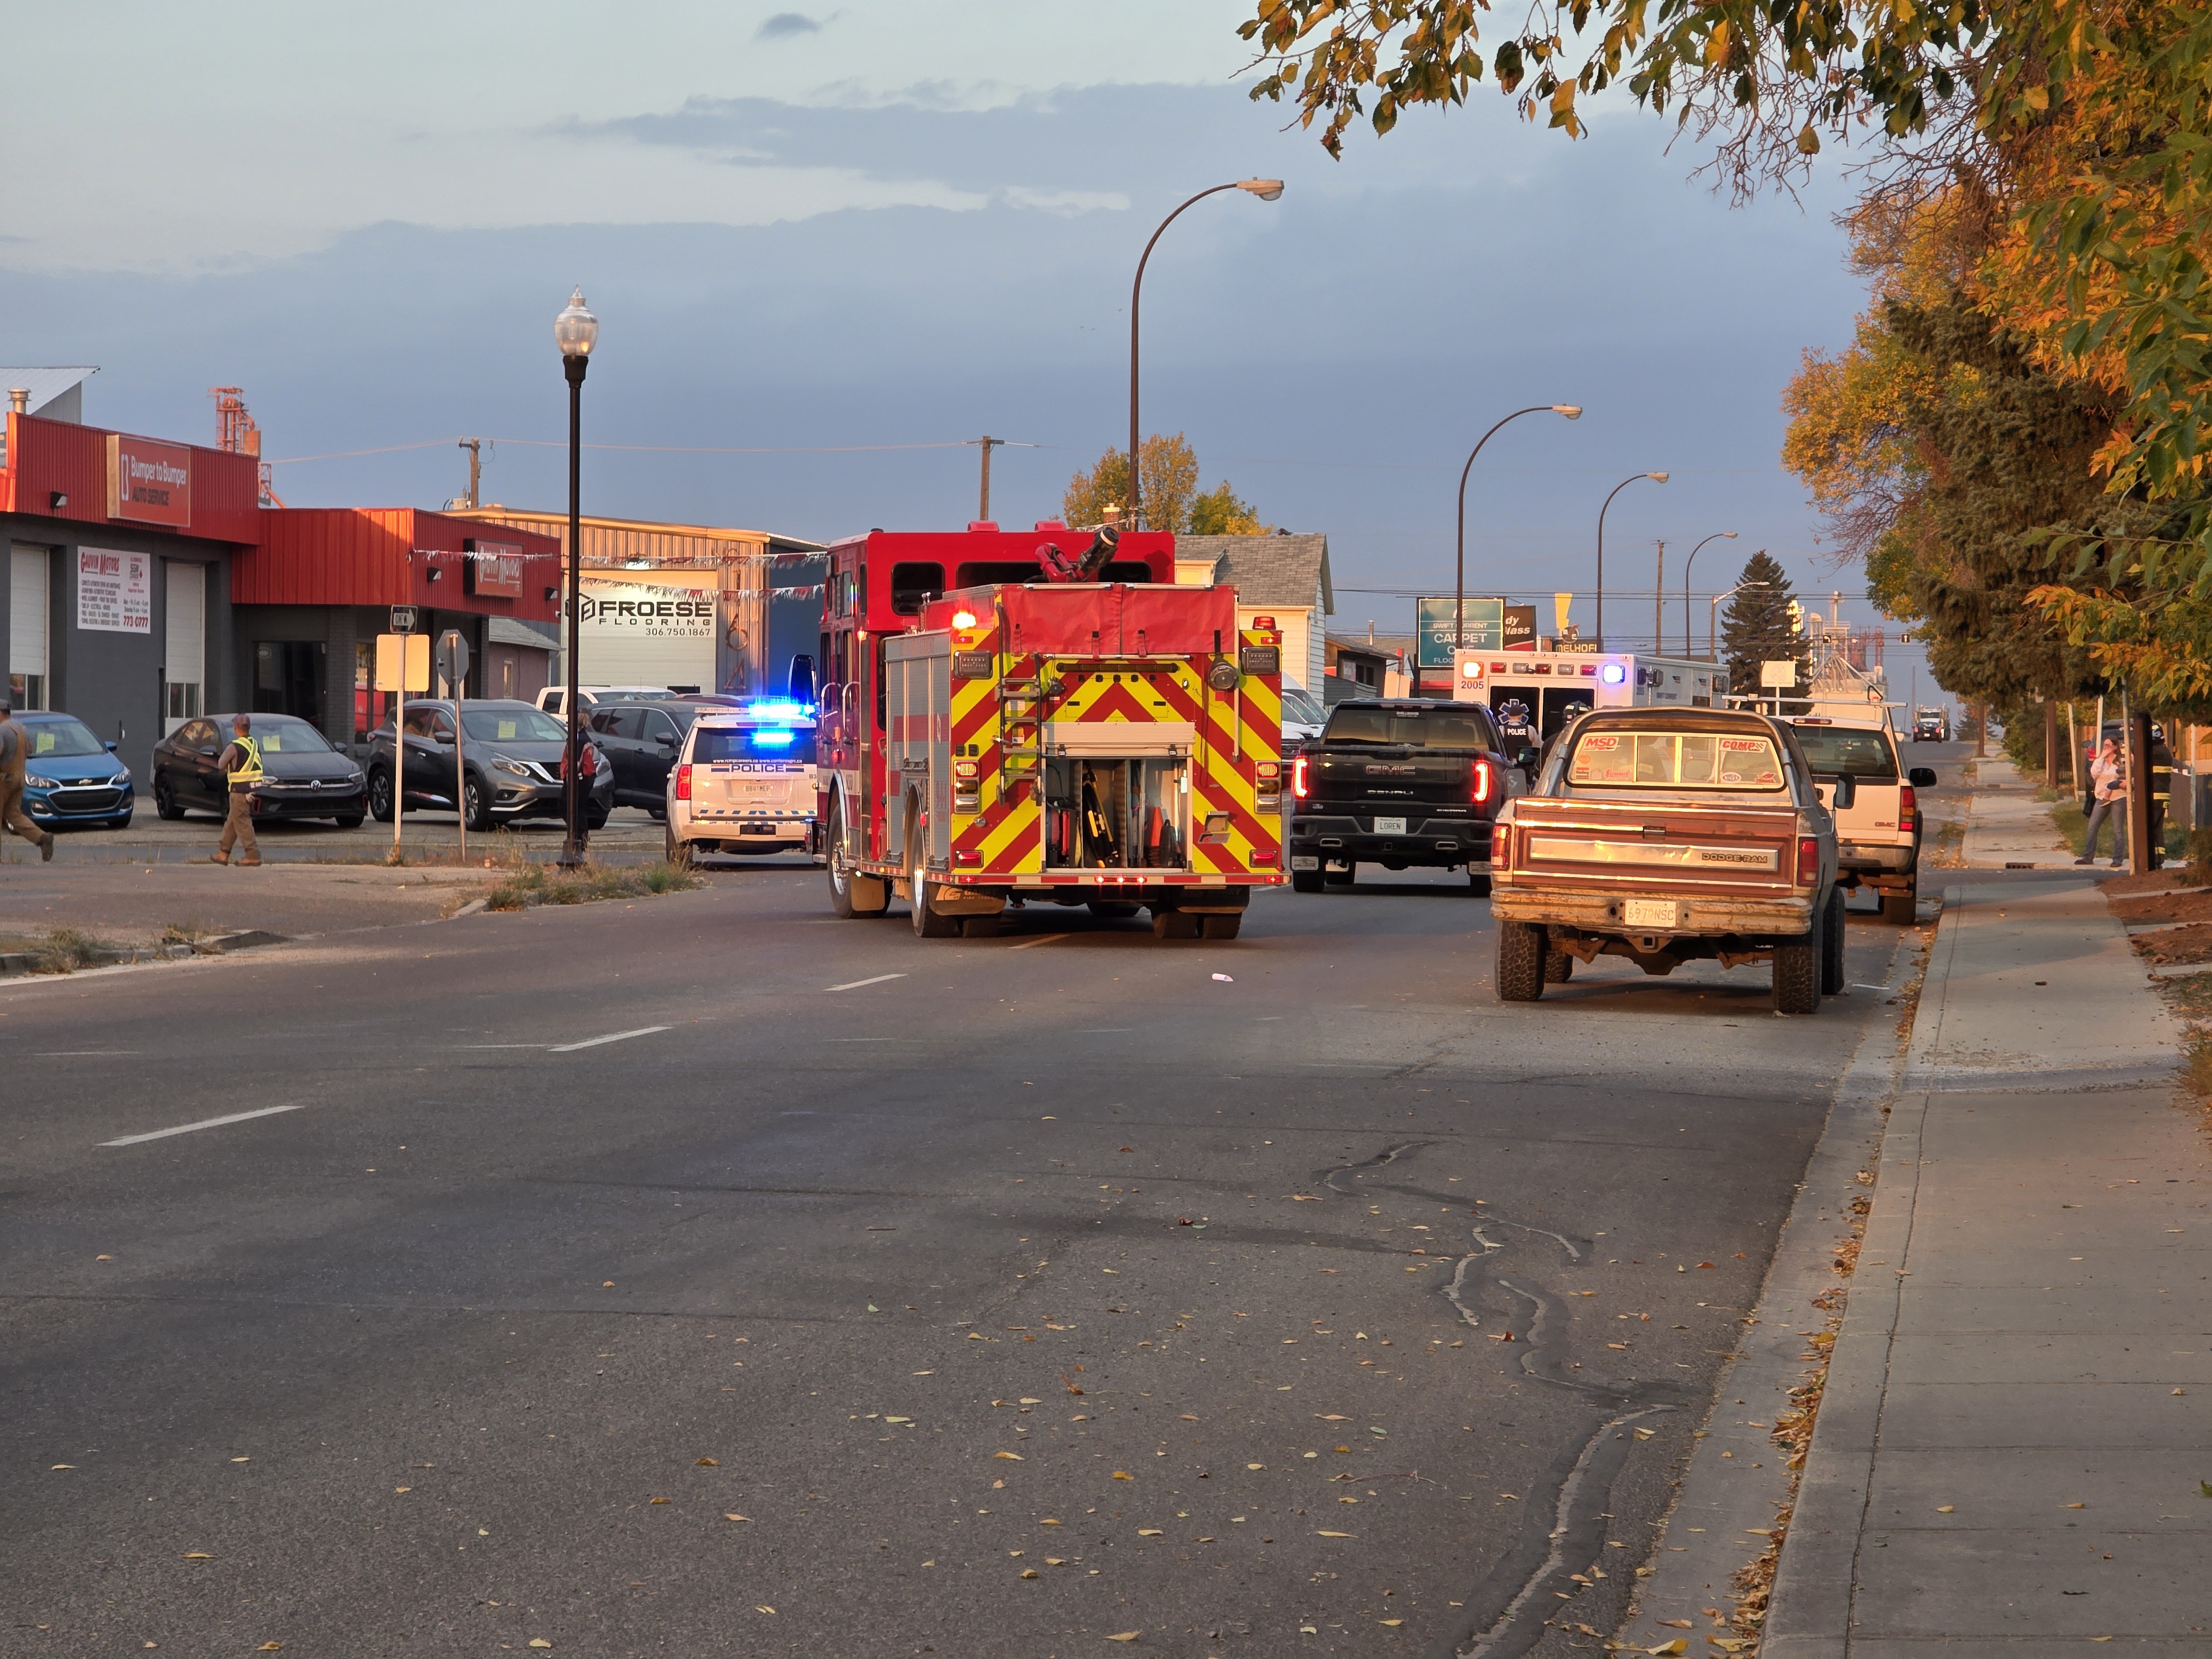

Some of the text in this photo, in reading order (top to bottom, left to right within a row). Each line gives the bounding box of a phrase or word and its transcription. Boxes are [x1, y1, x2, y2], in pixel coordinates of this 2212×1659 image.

[132, 456, 186, 488] Bumper to Bumper
[132, 486, 169, 507] AUTO SERVICE
[599, 601, 712, 617] FROESE
[1461, 681, 1484, 689] 2005
[1585, 738, 1617, 747] MSD
[1723, 741, 1756, 749] COMP
[731, 764, 784, 773] POLICE
[1366, 765, 1416, 775] GMC
[1702, 853, 1768, 863] DODGE RAM
[1629, 907, 1673, 920] 697 NSC
